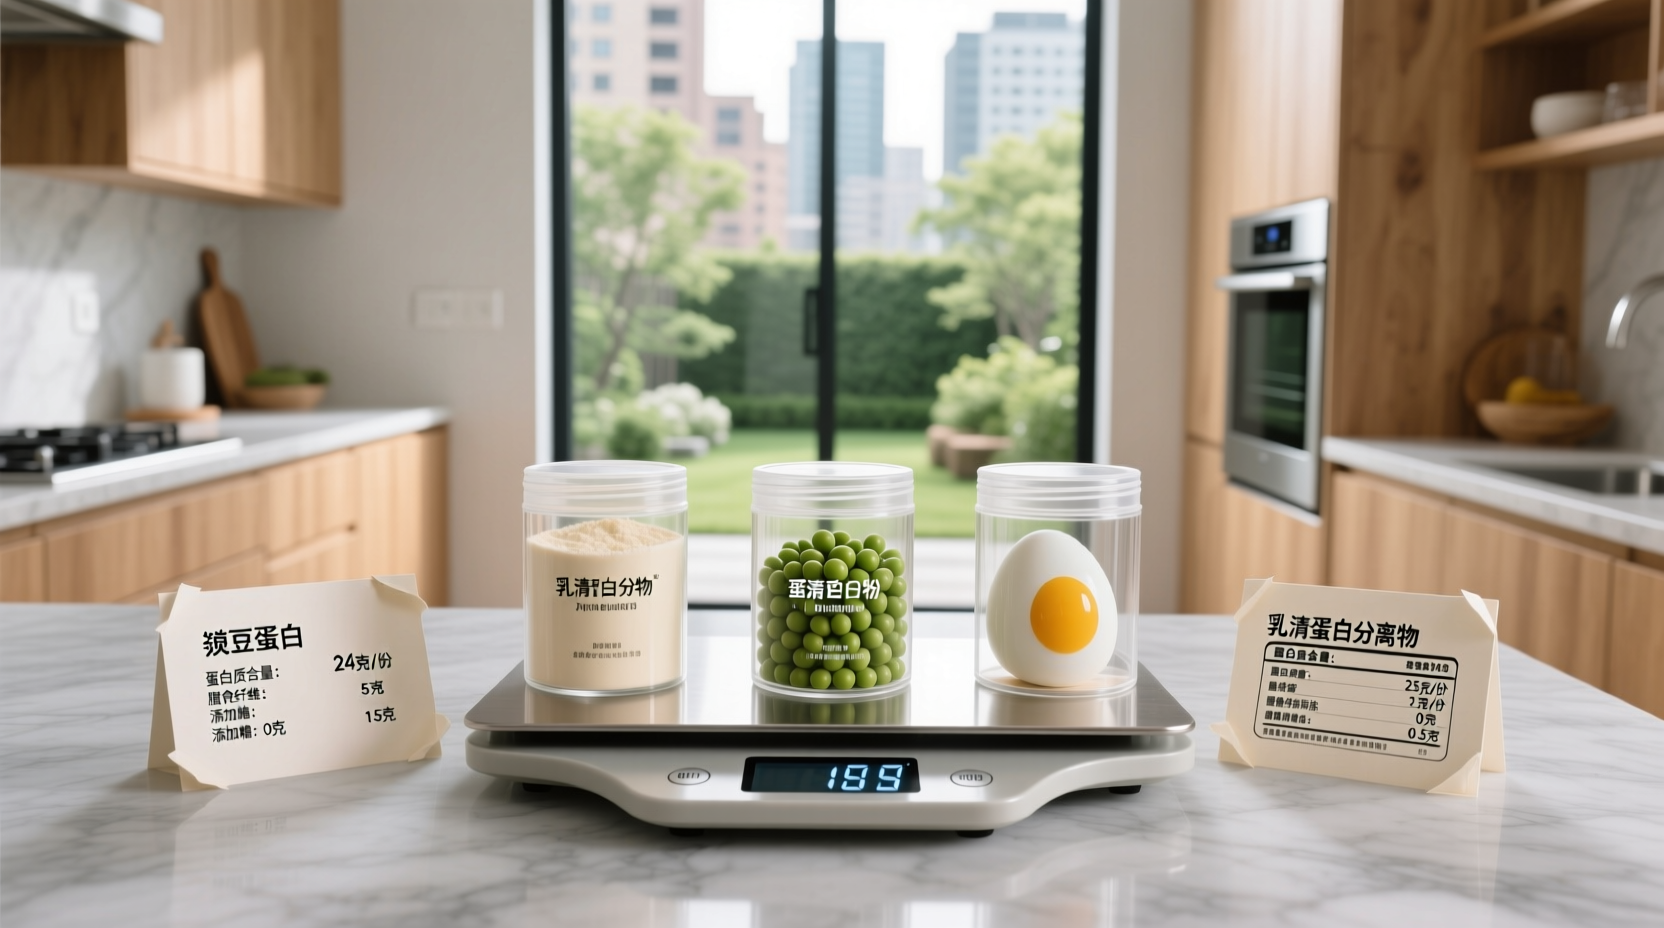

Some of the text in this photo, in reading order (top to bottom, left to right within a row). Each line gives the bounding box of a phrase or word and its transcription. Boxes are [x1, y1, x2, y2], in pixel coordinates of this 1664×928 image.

[1267, 613, 1420, 648] 乳清蛋白分离物
[365, 707, 396, 723] 15克
[263, 720, 286, 736] 0克
